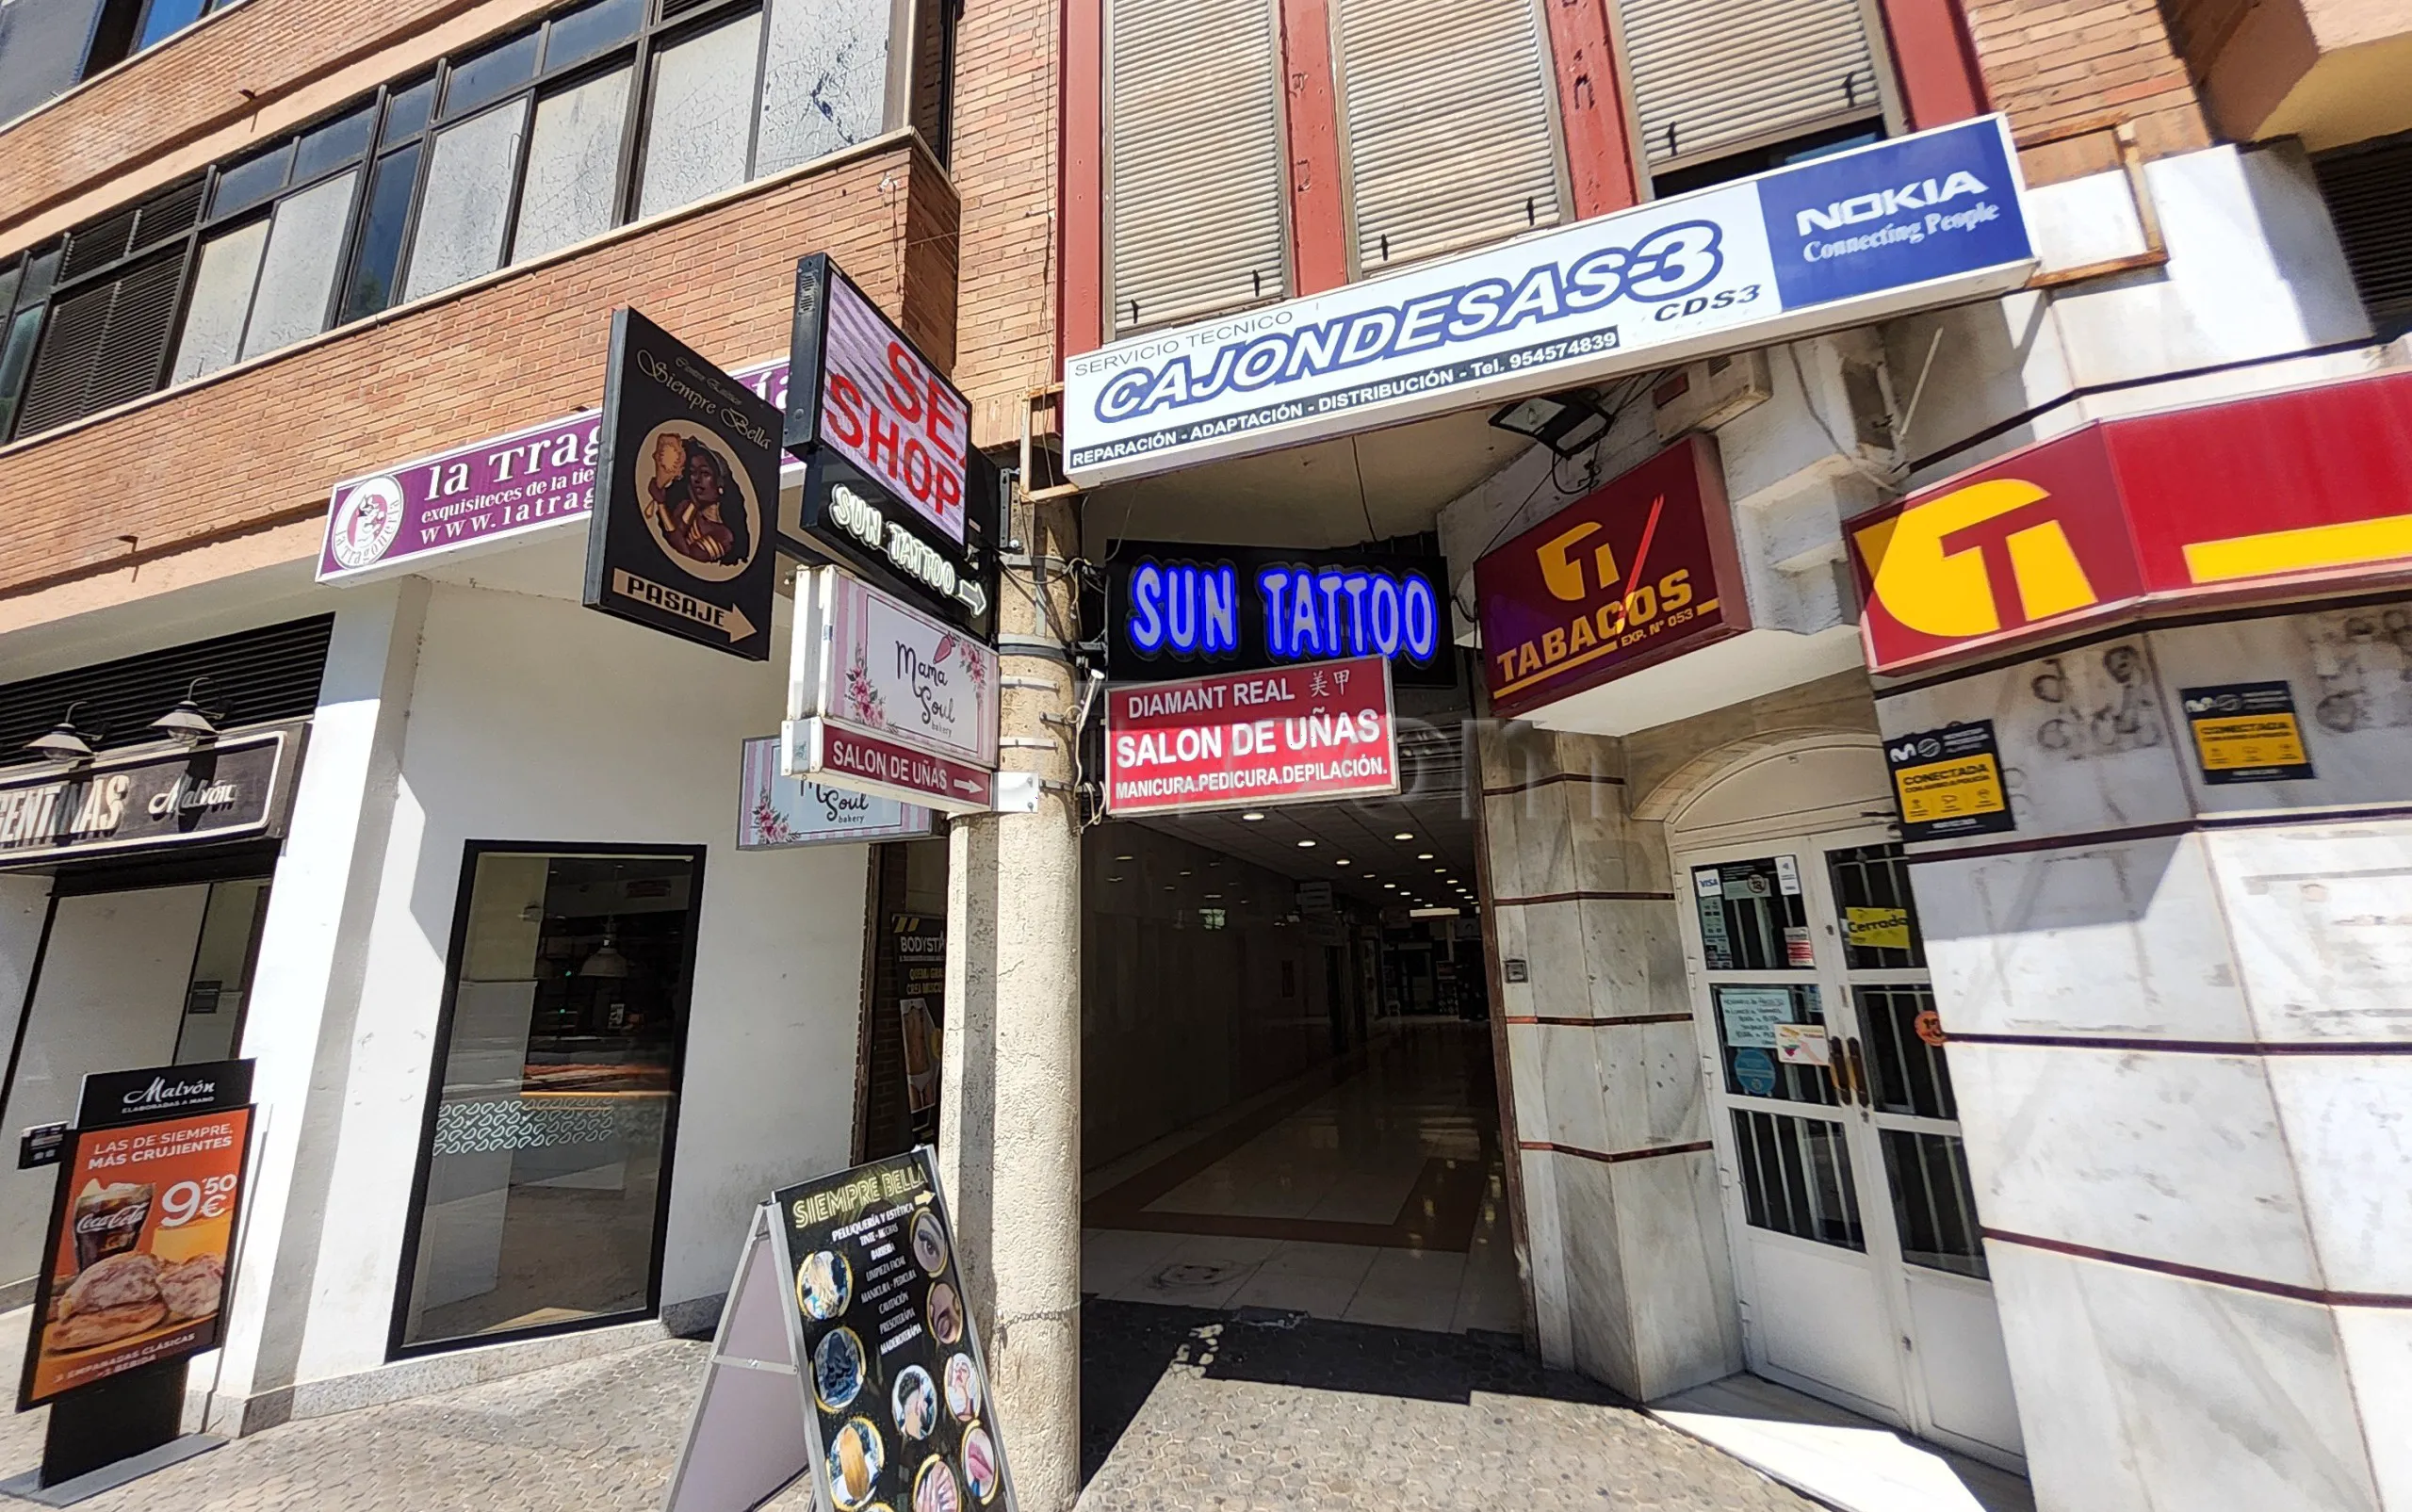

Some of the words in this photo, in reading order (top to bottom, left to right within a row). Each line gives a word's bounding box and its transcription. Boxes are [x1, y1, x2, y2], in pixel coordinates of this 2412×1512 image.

[1797, 171, 1989, 236] NOKIA
[1803, 221, 1925, 263] Connecting
[1926, 201, 1999, 236] People
[1654, 284, 1760, 321] CDS3
[1075, 340, 1179, 377] SERVICIO
[1186, 311, 1293, 348] TECNICO
[637, 350, 716, 414] Siempre
[721, 407, 772, 449] Bella
[885, 341, 967, 468] SE
[1072, 431, 1177, 466] REPARACIÓN
[1190, 402, 1302, 441] ADAPTACIÓN
[1319, 368, 1454, 412] DISTRIBUCIÓN
[1471, 357, 1504, 380] Tel.
[1509, 333, 1616, 368] 954574839
[826, 372, 960, 516] SHOP
[421, 486, 522, 524] exquisiteces
[526, 480, 546, 496] de
[549, 475, 567, 492] la
[424, 463, 469, 501] la
[830, 482, 882, 547] SUN
[887, 521, 955, 597] TATTOO
[627, 577, 725, 626] PASAJE
[1131, 563, 1237, 652] SUN
[1259, 568, 1437, 658] TATTOO
[1497, 568, 1692, 682] TABACOS
[1621, 630, 1647, 648] EXP.
[1668, 609, 1693, 627] 053
[896, 640, 948, 698] Mama
[1309, 669, 1350, 698] 美甲
[921, 686, 955, 724] Soul
[1128, 685, 1227, 719] DIAMANT
[1233, 677, 1295, 707] REAL
[931, 721, 952, 738] bakery
[1116, 726, 1222, 768] SALON
[1231, 720, 1277, 756] DE
[1285, 707, 1380, 751] UÑAS
[833, 740, 887, 775] SALON
[890, 759, 909, 781] DE
[912, 757, 947, 790] UÑAS
[826, 789, 869, 821] Soul
[839, 813, 865, 824] bakery
[1700, 879, 1718, 887] VISA
[122, 1076, 215, 1104] Malvón
[88, 1154, 127, 1170] MÁS
[131, 1135, 233, 1162] CRUJIENTES
[94, 1139, 128, 1155] LAS
[133, 1134, 157, 1148] DE
[792, 1177, 881, 1229] SIEMPRE
[882, 1162, 929, 1197] BELLA
[832, 1213, 881, 1242] PELUQUERÍA
[887, 1202, 914, 1224] ESTÉTICA
